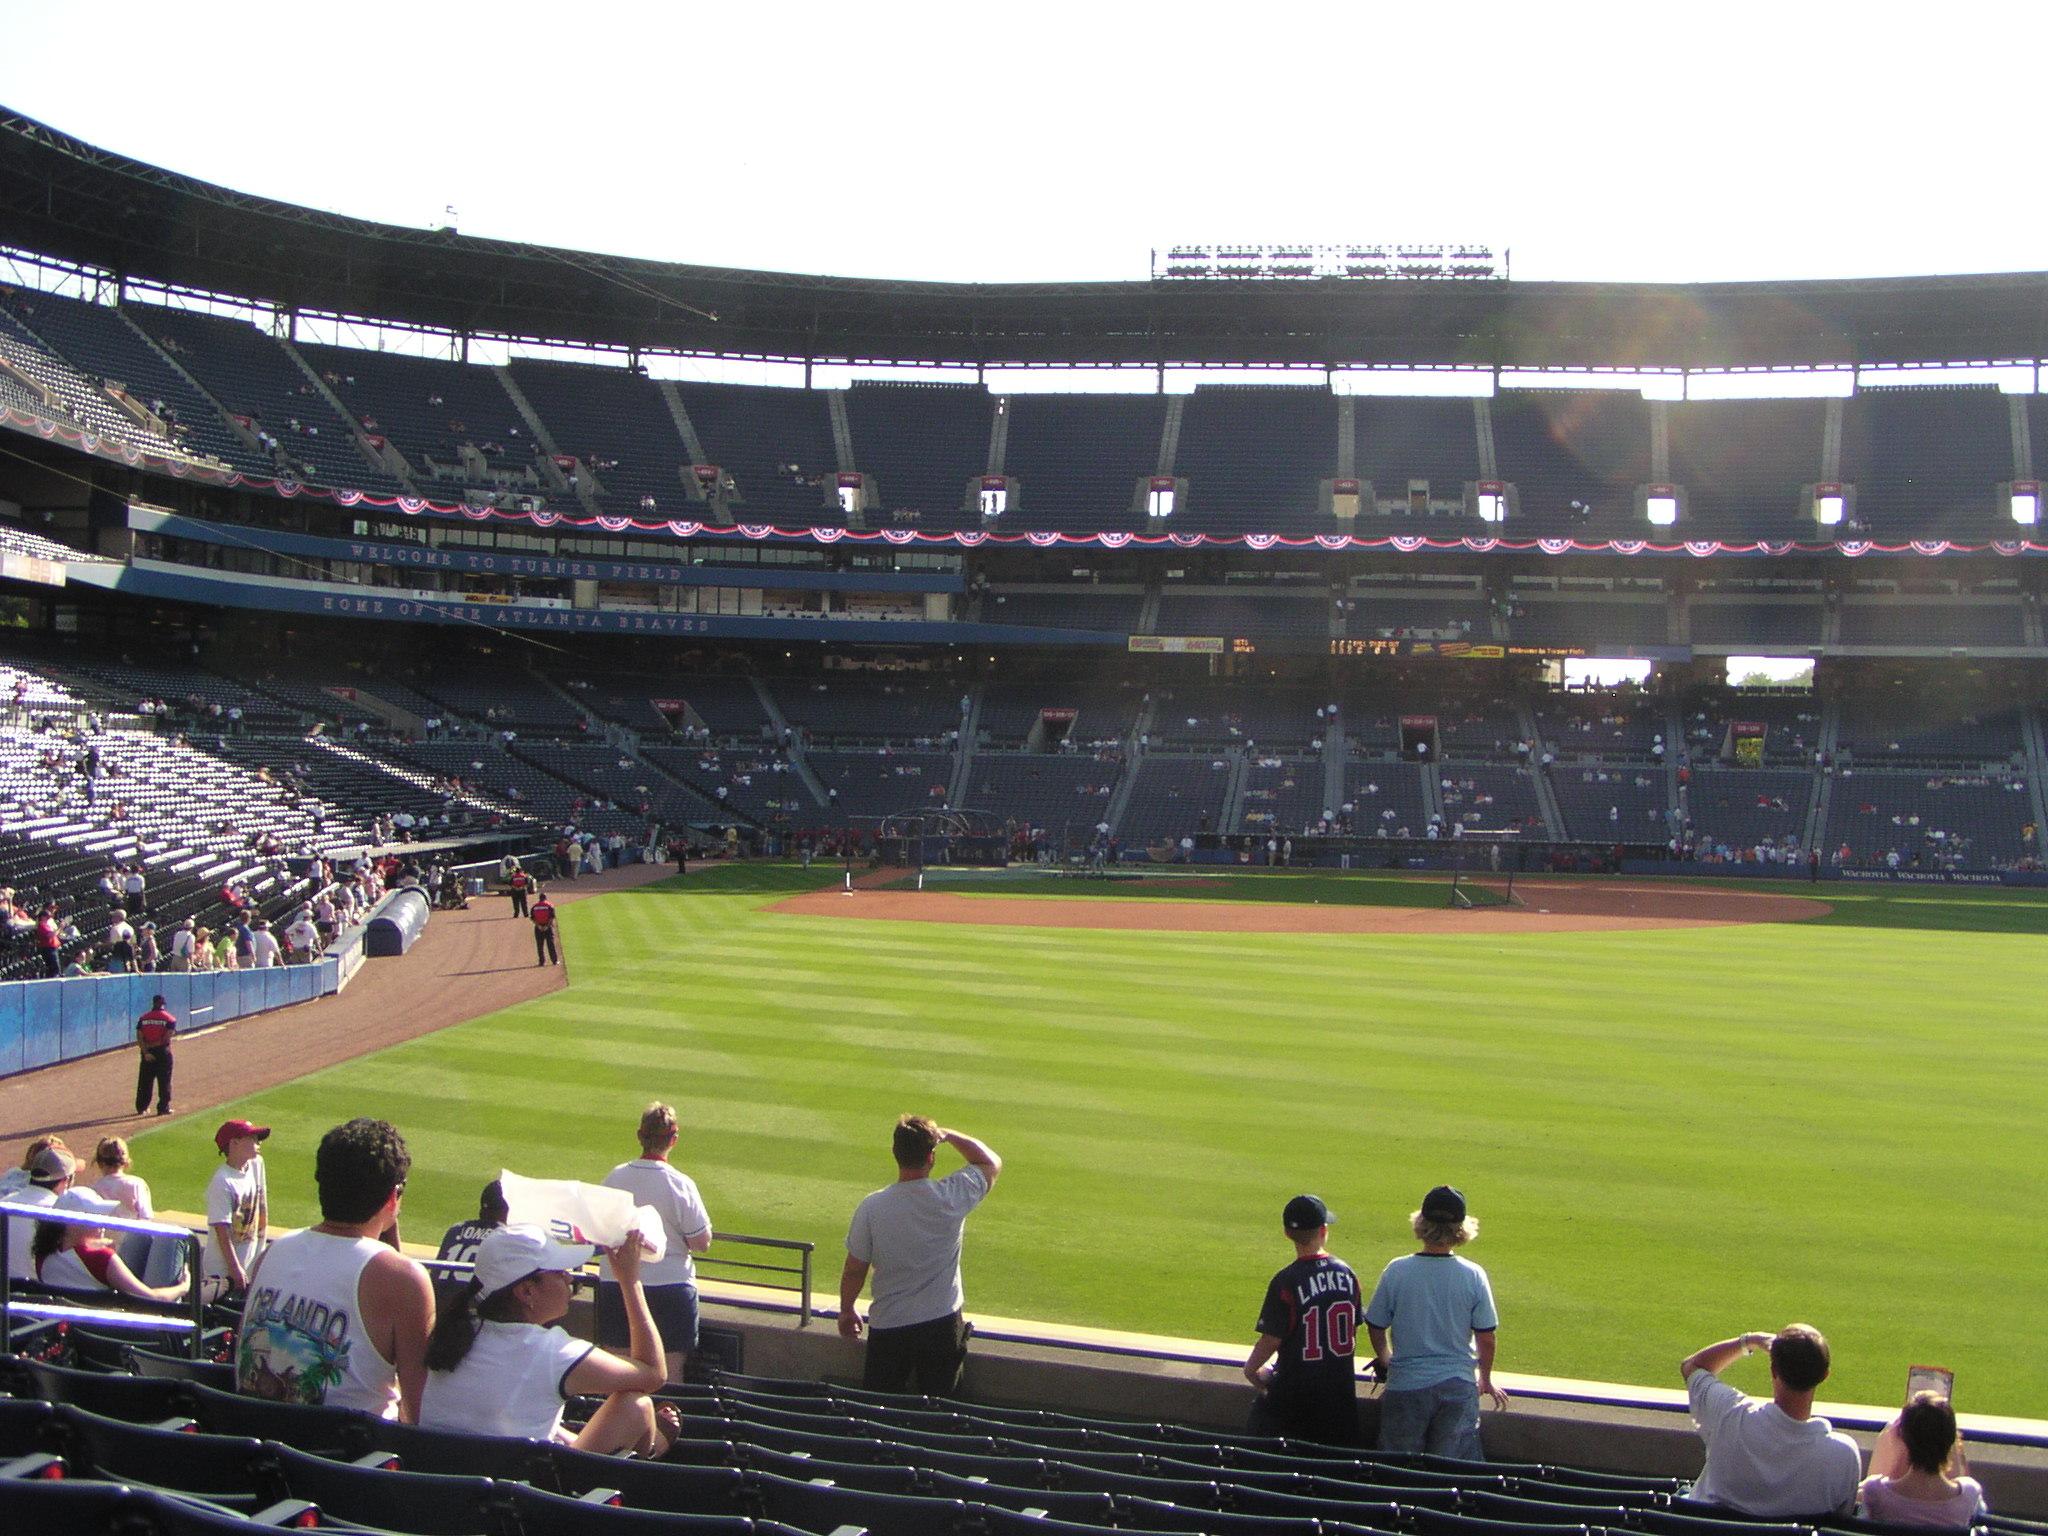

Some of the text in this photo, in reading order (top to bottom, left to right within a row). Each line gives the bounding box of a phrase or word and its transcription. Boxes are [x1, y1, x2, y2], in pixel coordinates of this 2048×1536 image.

[350, 544, 682, 580] WELCOME TO TURNER FIELD
[323, 597, 709, 632] HOME OF THE ATLANTA BRAVES
[1298, 1271, 1354, 1304] LACKEY
[1302, 1300, 1356, 1361] 10
